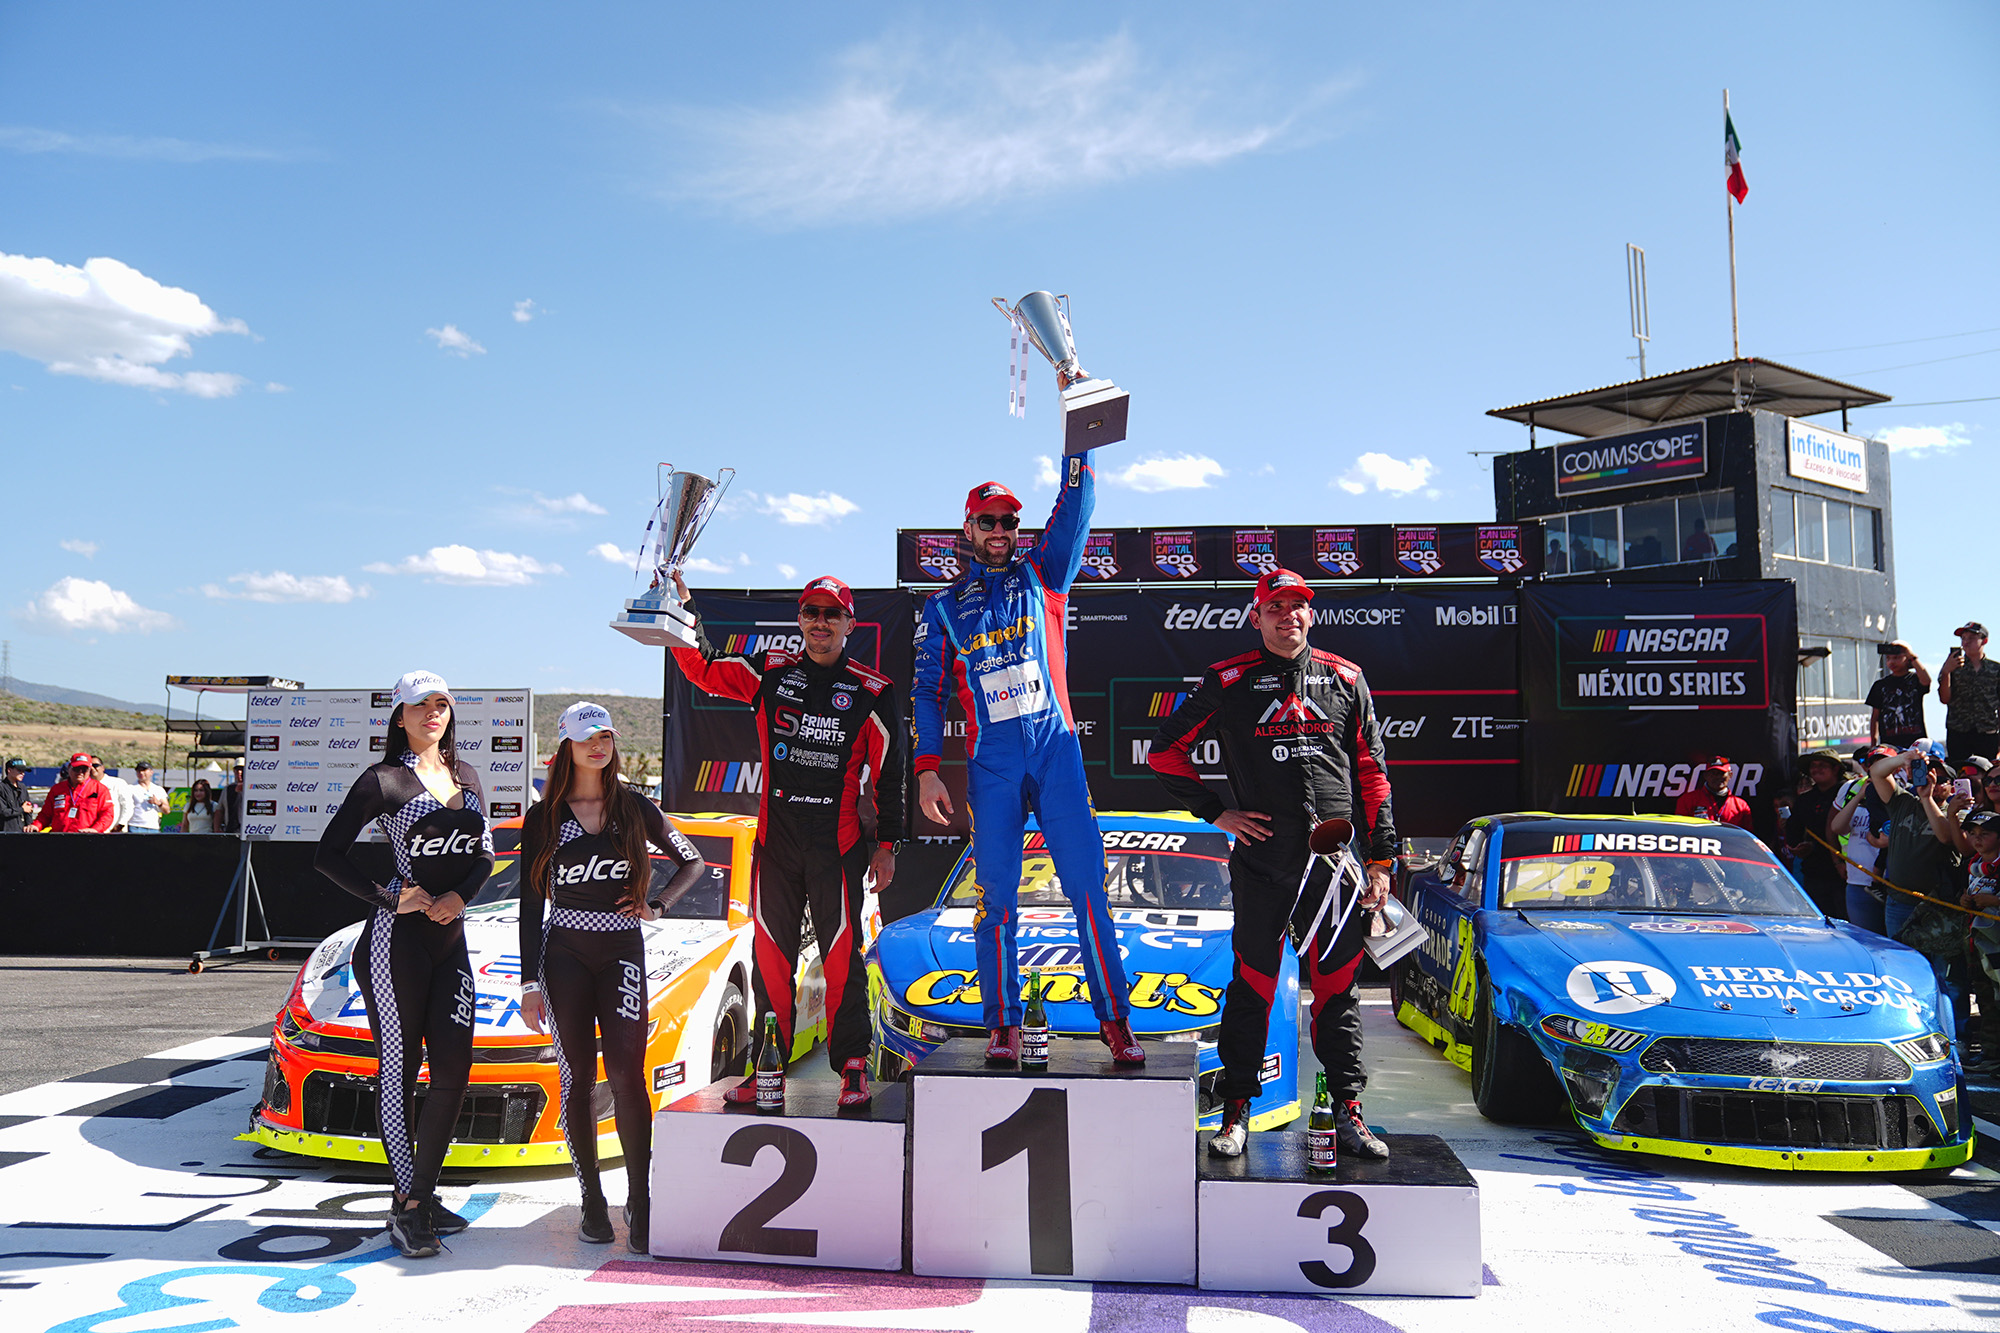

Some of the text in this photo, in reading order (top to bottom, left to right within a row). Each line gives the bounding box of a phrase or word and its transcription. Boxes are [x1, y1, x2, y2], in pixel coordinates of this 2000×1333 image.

[1562, 434, 1694, 474] COMMSCOPE
[1791, 429, 1861, 469] infinitum
[1155, 544, 1192, 556] CAPITAL
[1237, 542, 1273, 553] CAPITAL
[1317, 541, 1354, 552] CAPITAL
[1398, 540, 1435, 551] CAPITAL
[1480, 538, 1516, 550] CAPITAL
[921, 547, 955, 556] CAPITAL
[1317, 552, 1355, 563] 200
[1398, 550, 1437, 562] 200
[1480, 549, 1518, 561] 200
[920, 556, 957, 566] 200
[1155, 555, 1191, 565] 200
[1236, 553, 1274, 564] 200
[1080, 613, 1127, 622] SMARTPHONES
[1163, 603, 1254, 630] telcel
[1435, 605, 1499, 626] Mobil
[1626, 627, 1730, 652] NASCAR
[1221, 668, 1239, 681] OMP
[1304, 675, 1335, 685] telcel
[1578, 668, 1746, 697] MÉXICO SERIES
[985, 682, 1026, 704] Mobil
[250, 695, 283, 706] telcel
[291, 696, 307, 706] ZTE
[578, 710, 606, 721] telcel
[289, 717, 322, 728] telcel
[329, 717, 345, 727] ZTE
[492, 719, 515, 727] Mobil
[1452, 716, 1494, 738] ZTE
[799, 725, 846, 742] SPORTS
[1254, 722, 1335, 737] ALESSANDROS
[296, 739, 320, 747] NASCAR
[328, 738, 361, 749] telcel
[790, 747, 839, 762] MARKETING
[1132, 739, 1221, 765] MCO
[247, 760, 280, 771] telcel
[490, 761, 523, 772] telcel
[795, 757, 838, 769] ADVERTISING
[286, 781, 319, 792] telcel
[327, 782, 343, 792] ZTE
[286, 805, 309, 813] Mobil
[244, 824, 277, 835] telcel
[285, 825, 301, 835] ZTE
[410, 828, 480, 857] telce
[667, 830, 698, 861] telcel
[1102, 831, 1187, 851] SCAR
[1595, 834, 1723, 856] NASCAR
[1504, 860, 1616, 903] 28
[1425, 908, 1447, 930] GRUPO
[1688, 965, 1913, 994] HERALDO
[616, 959, 641, 1021] telcel
[906, 968, 1225, 1016] Cnl's
[1701, 982, 1809, 1001] MEDIA
[450, 969, 475, 1028] telcel
[908, 1016, 923, 1039] 88
[1581, 1022, 1609, 1045] 28
[1311, 1150, 1334, 1160] SERIES
[981, 1088, 1074, 1276] 1
[717, 1123, 818, 1258] 2
[1297, 1190, 1376, 1289] 3
